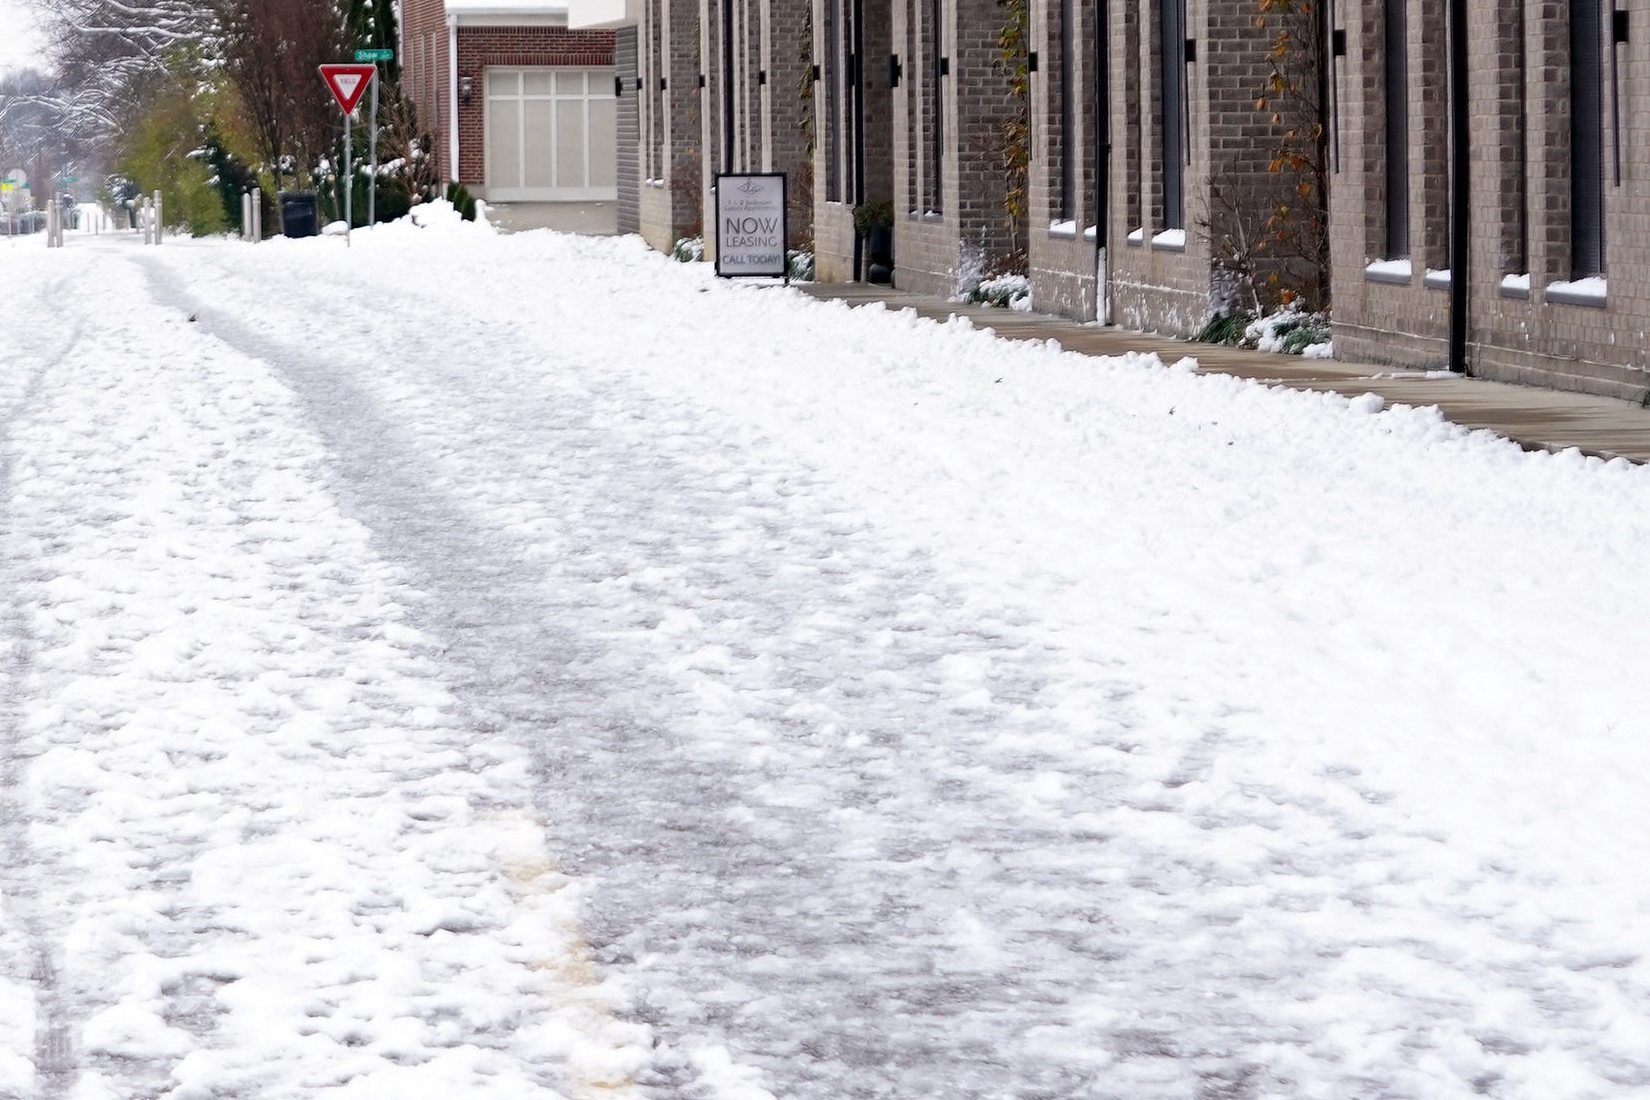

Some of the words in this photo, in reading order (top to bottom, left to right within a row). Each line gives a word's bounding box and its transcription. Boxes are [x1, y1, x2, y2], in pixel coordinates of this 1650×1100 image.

[358, 50, 378, 60] Shaw
[726, 217, 778, 234] NOW
[726, 236, 778, 247] LEASING
[722, 254, 746, 264] CALL
